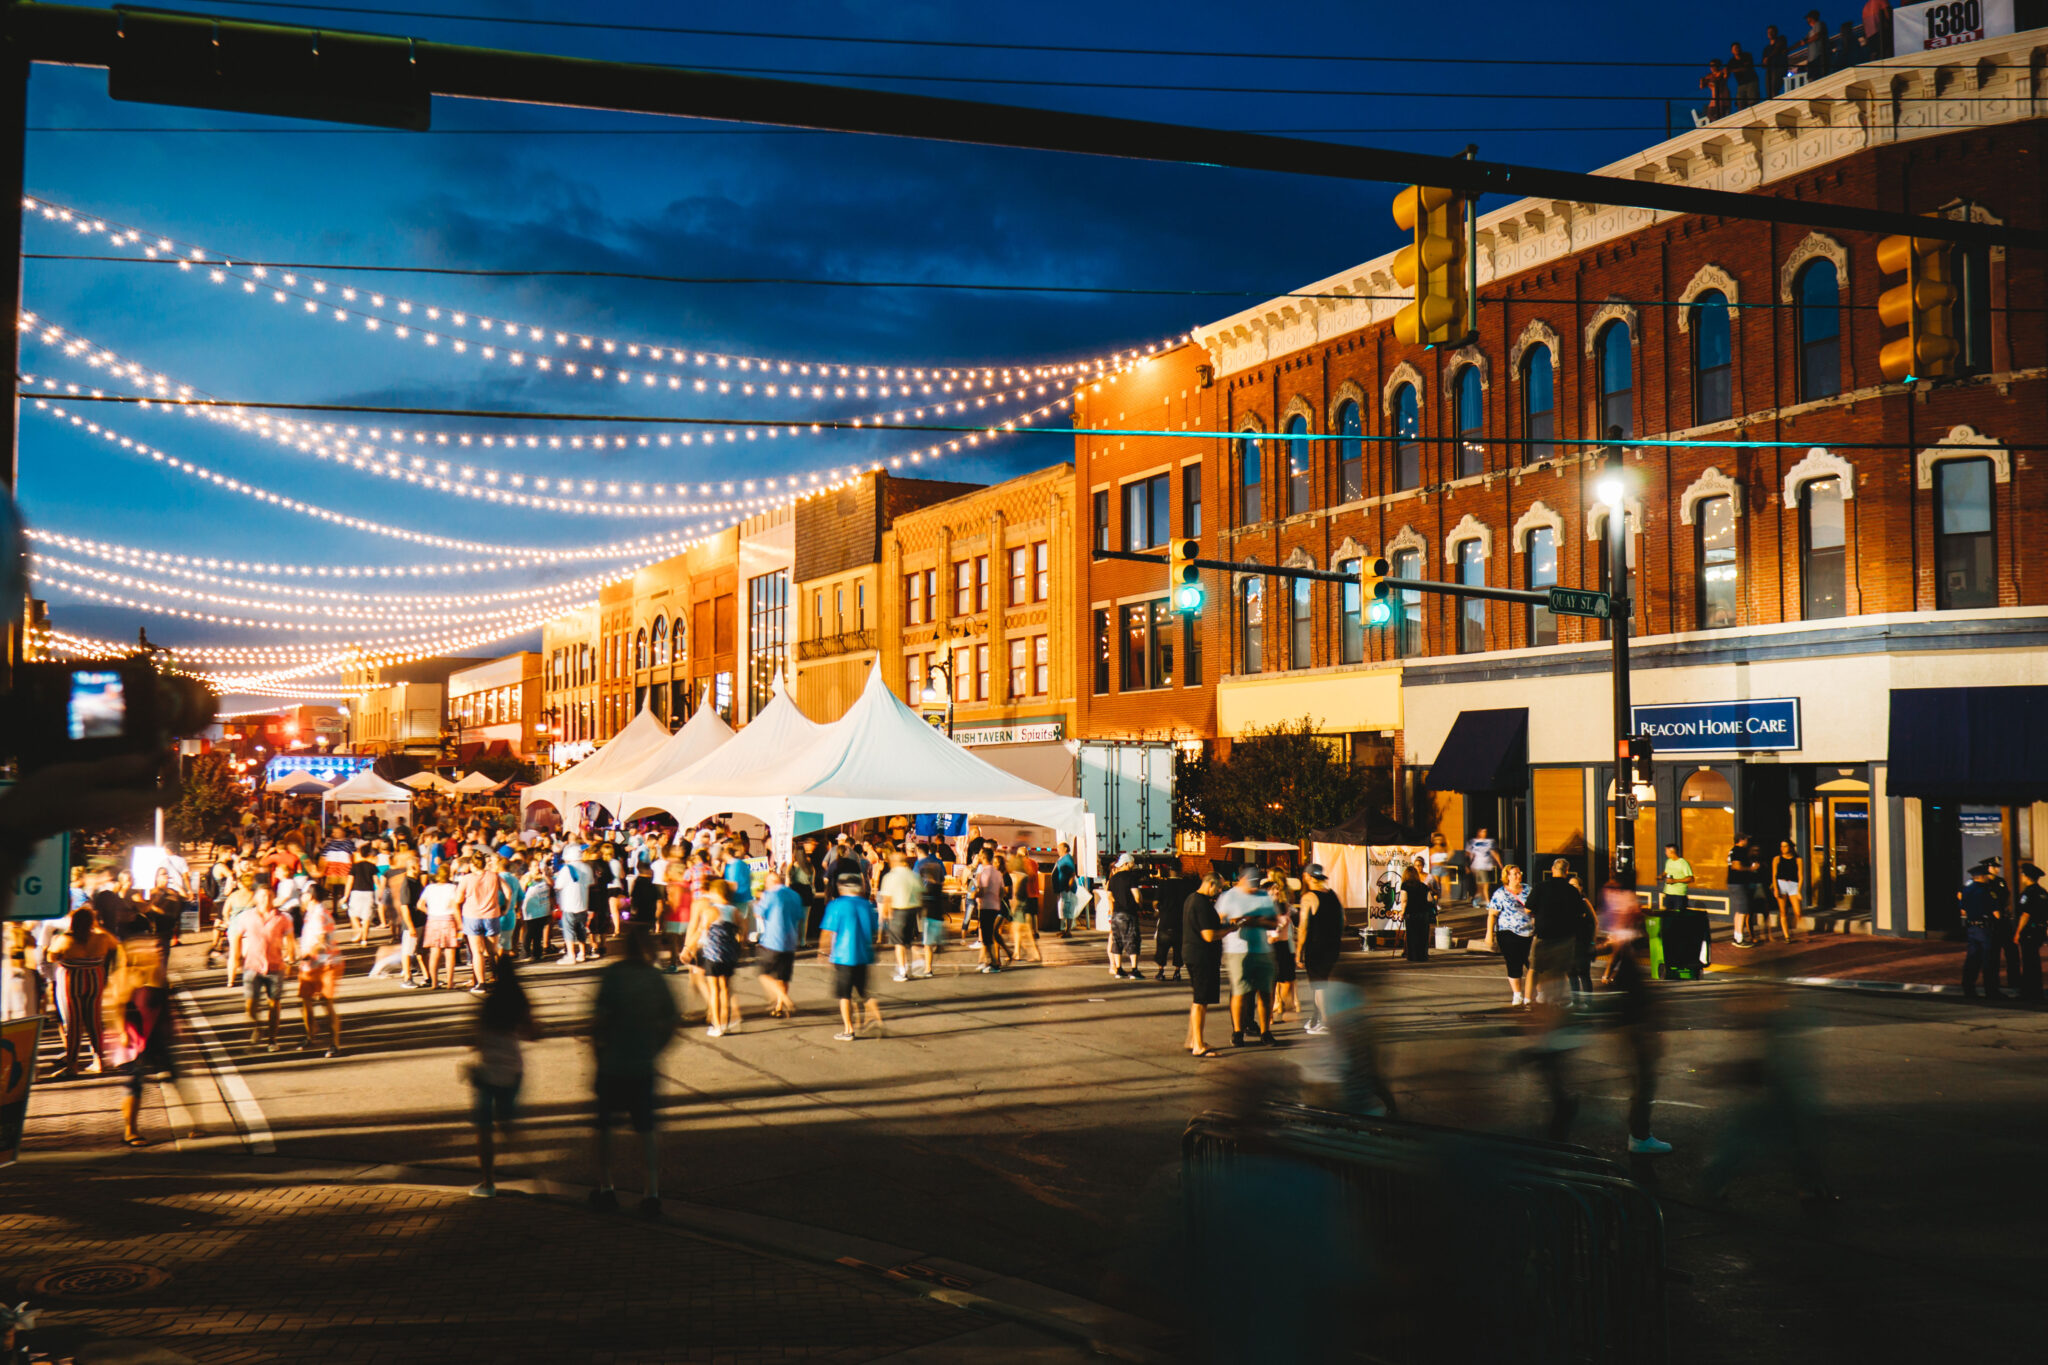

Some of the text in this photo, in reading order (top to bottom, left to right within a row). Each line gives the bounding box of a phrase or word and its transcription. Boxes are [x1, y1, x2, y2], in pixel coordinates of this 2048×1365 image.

[1926, 0, 1979, 39] 1380
[1931, 31, 1976, 48] am
[1552, 593, 1594, 610] QUAY ST.
[1640, 717, 1788, 737] BEACON HOME CARE
[953, 732, 976, 744] IRISH
[978, 730, 1013, 743] TAVERN
